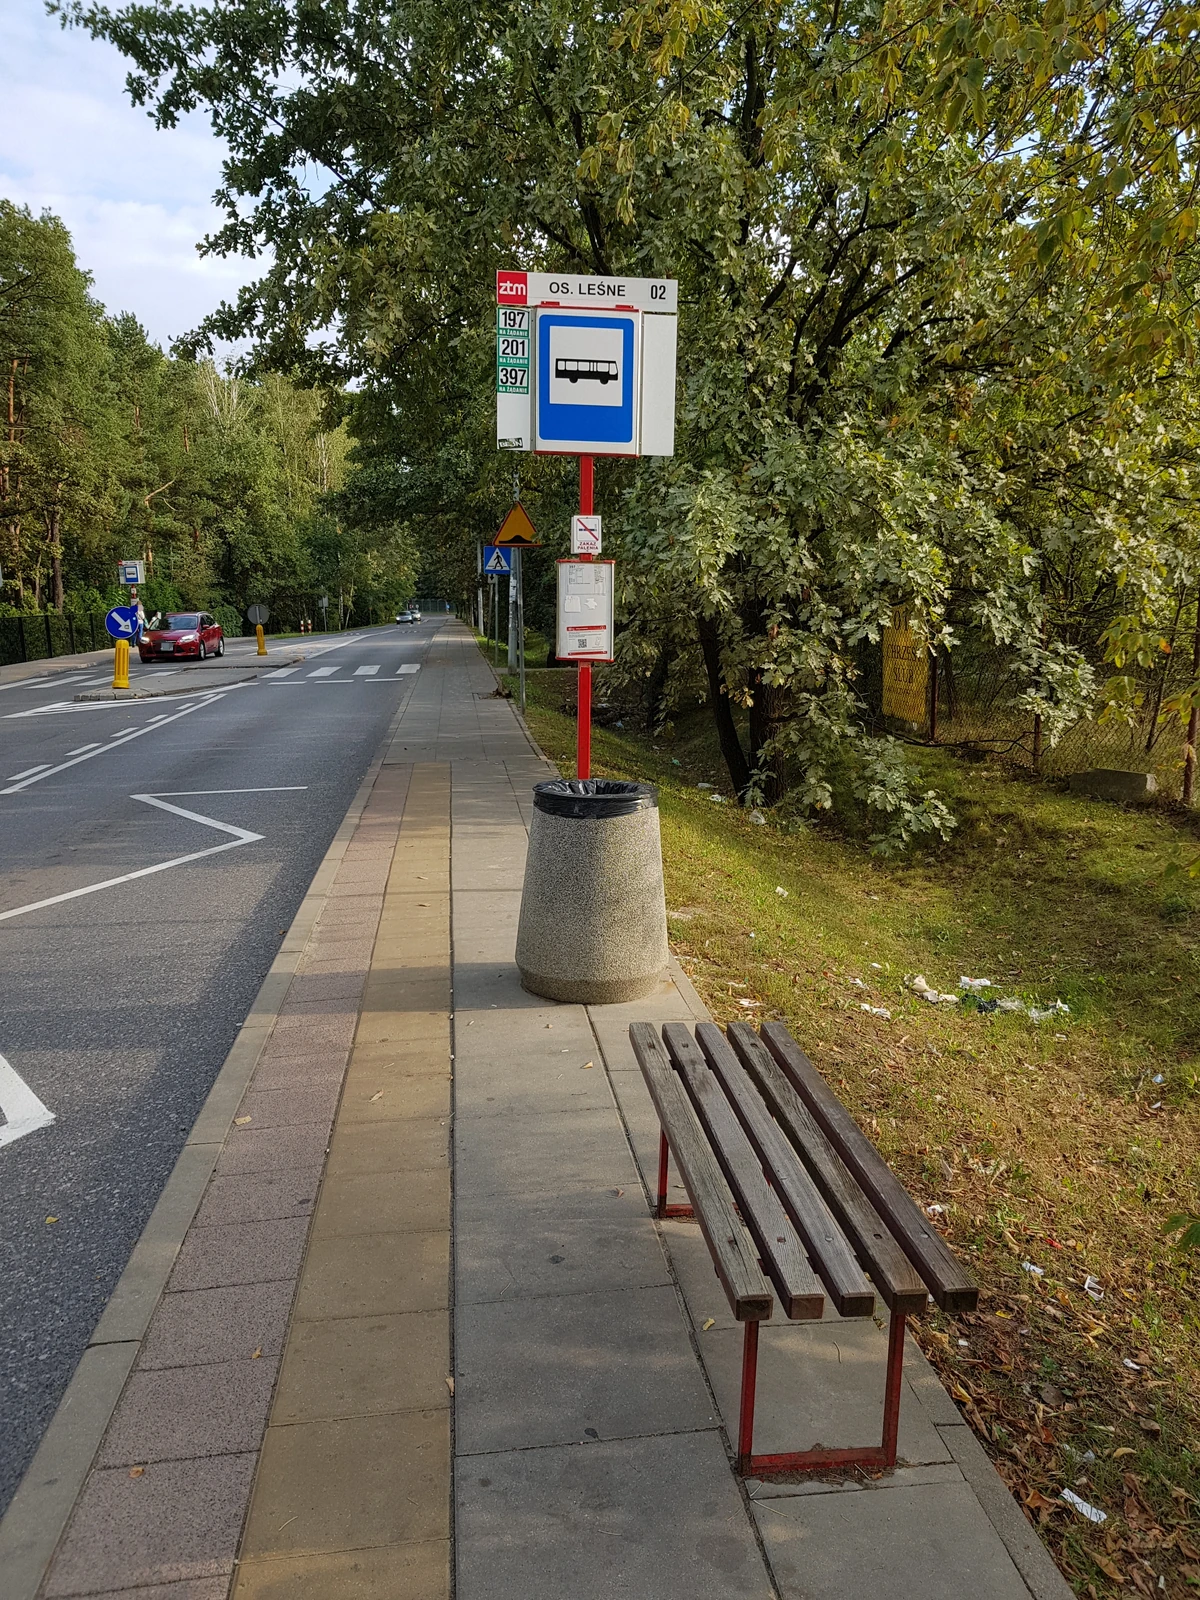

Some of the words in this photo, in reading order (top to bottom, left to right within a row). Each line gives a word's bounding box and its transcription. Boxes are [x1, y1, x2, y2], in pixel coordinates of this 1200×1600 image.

[499, 282, 526, 296] ztm
[549, 281, 574, 295] OS.
[578, 281, 626, 297] LEŚNE
[650, 285, 666, 300] 02
[502, 311, 525, 328] 197
[502, 339, 525, 356] 201
[500, 368, 526, 385] 397
